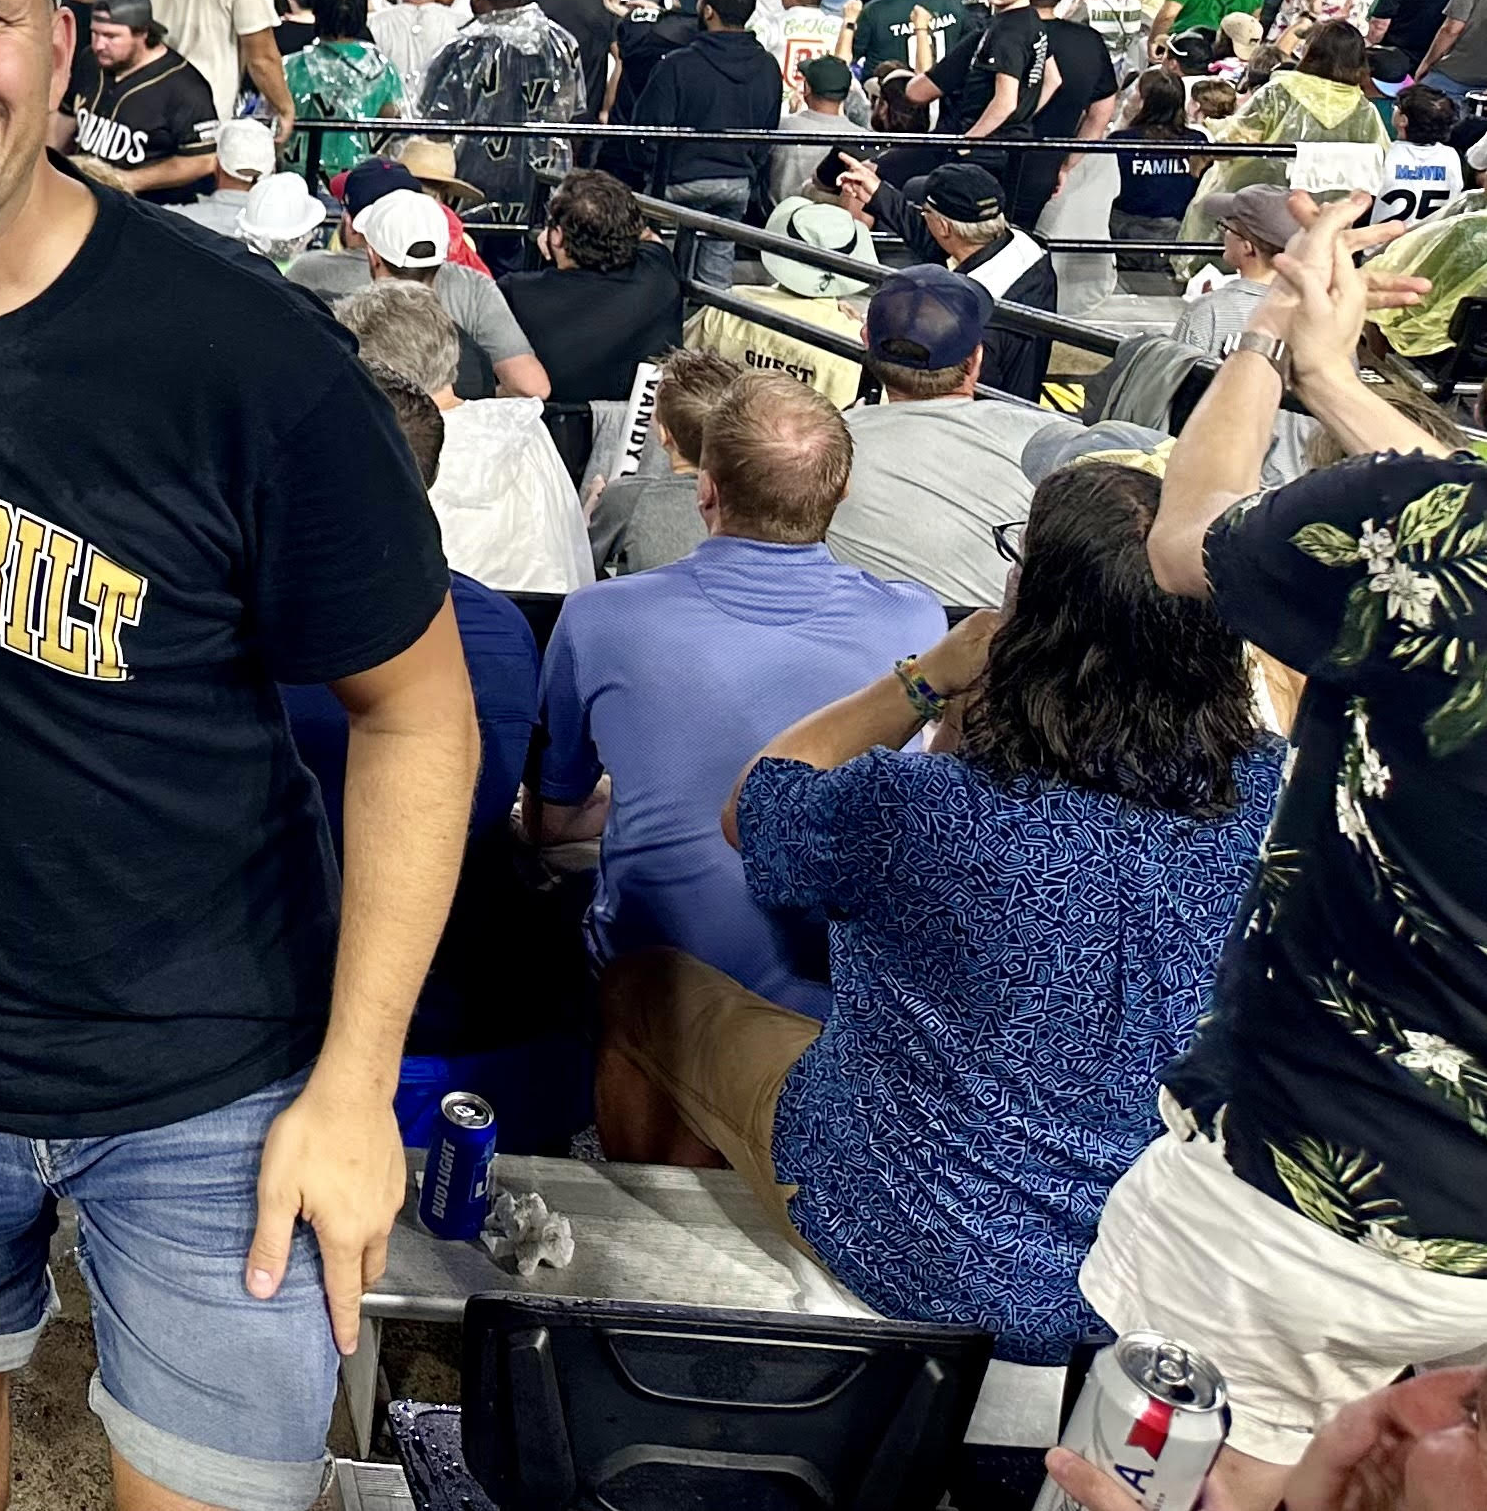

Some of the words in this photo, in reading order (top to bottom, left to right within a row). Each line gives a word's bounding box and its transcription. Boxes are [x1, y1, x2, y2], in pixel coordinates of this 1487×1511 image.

[1132, 158, 1190, 176] FAMILY
[745, 349, 814, 384] GUEST
[626, 379, 659, 461] VANDY
[436, 1137, 456, 1187] LIGHT
[431, 1183, 448, 1220] BUD
